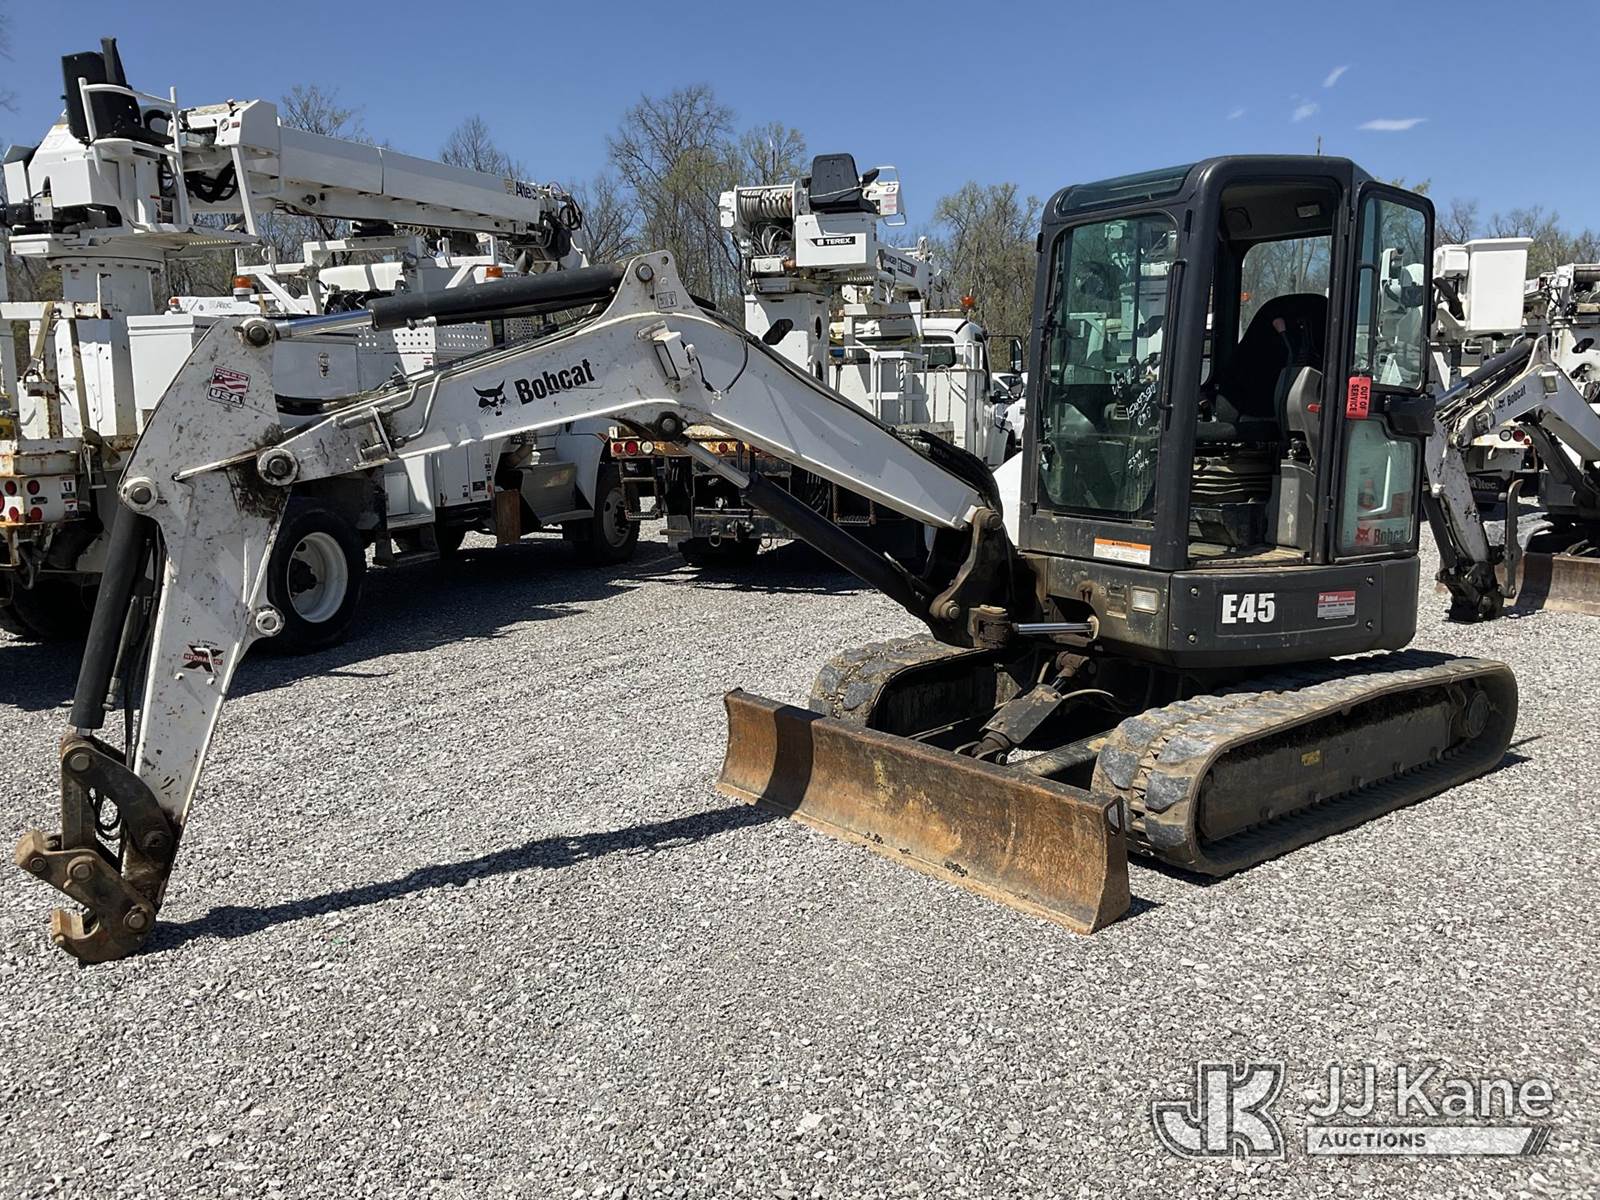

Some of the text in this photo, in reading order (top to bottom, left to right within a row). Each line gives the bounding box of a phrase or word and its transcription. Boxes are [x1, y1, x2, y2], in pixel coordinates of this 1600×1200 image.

[826, 237, 851, 245] TEREX
[514, 358, 596, 406] Bobcat
[211, 389, 241, 403] USA
[1349, 384, 1360, 411] SERVICE
[1359, 385, 1369, 410] OUT OF
[1221, 592, 1276, 625] E45
